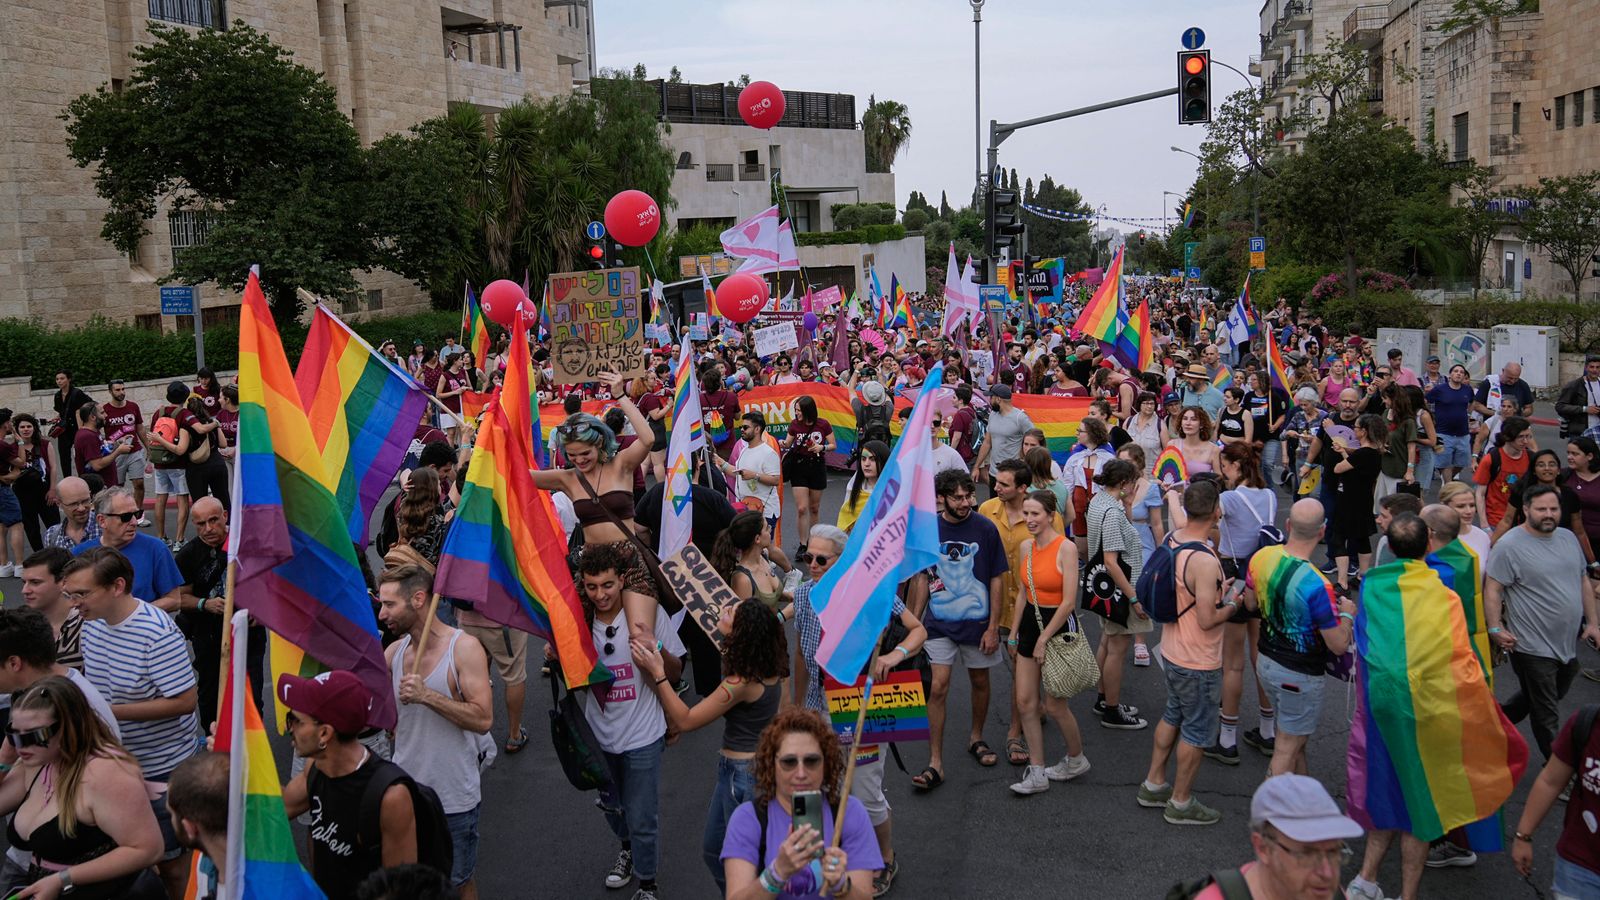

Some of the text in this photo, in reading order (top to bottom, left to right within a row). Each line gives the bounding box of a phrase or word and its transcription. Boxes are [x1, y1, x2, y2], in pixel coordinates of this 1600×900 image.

[607, 270, 637, 297] גם
[553, 296, 638, 323] פנטזיות
[554, 320, 611, 344] זכויות
[612, 318, 639, 344] על
[595, 340, 642, 360] שאני לא
[617, 355, 642, 372] יכולה
[872, 689, 920, 706] ואהבת
